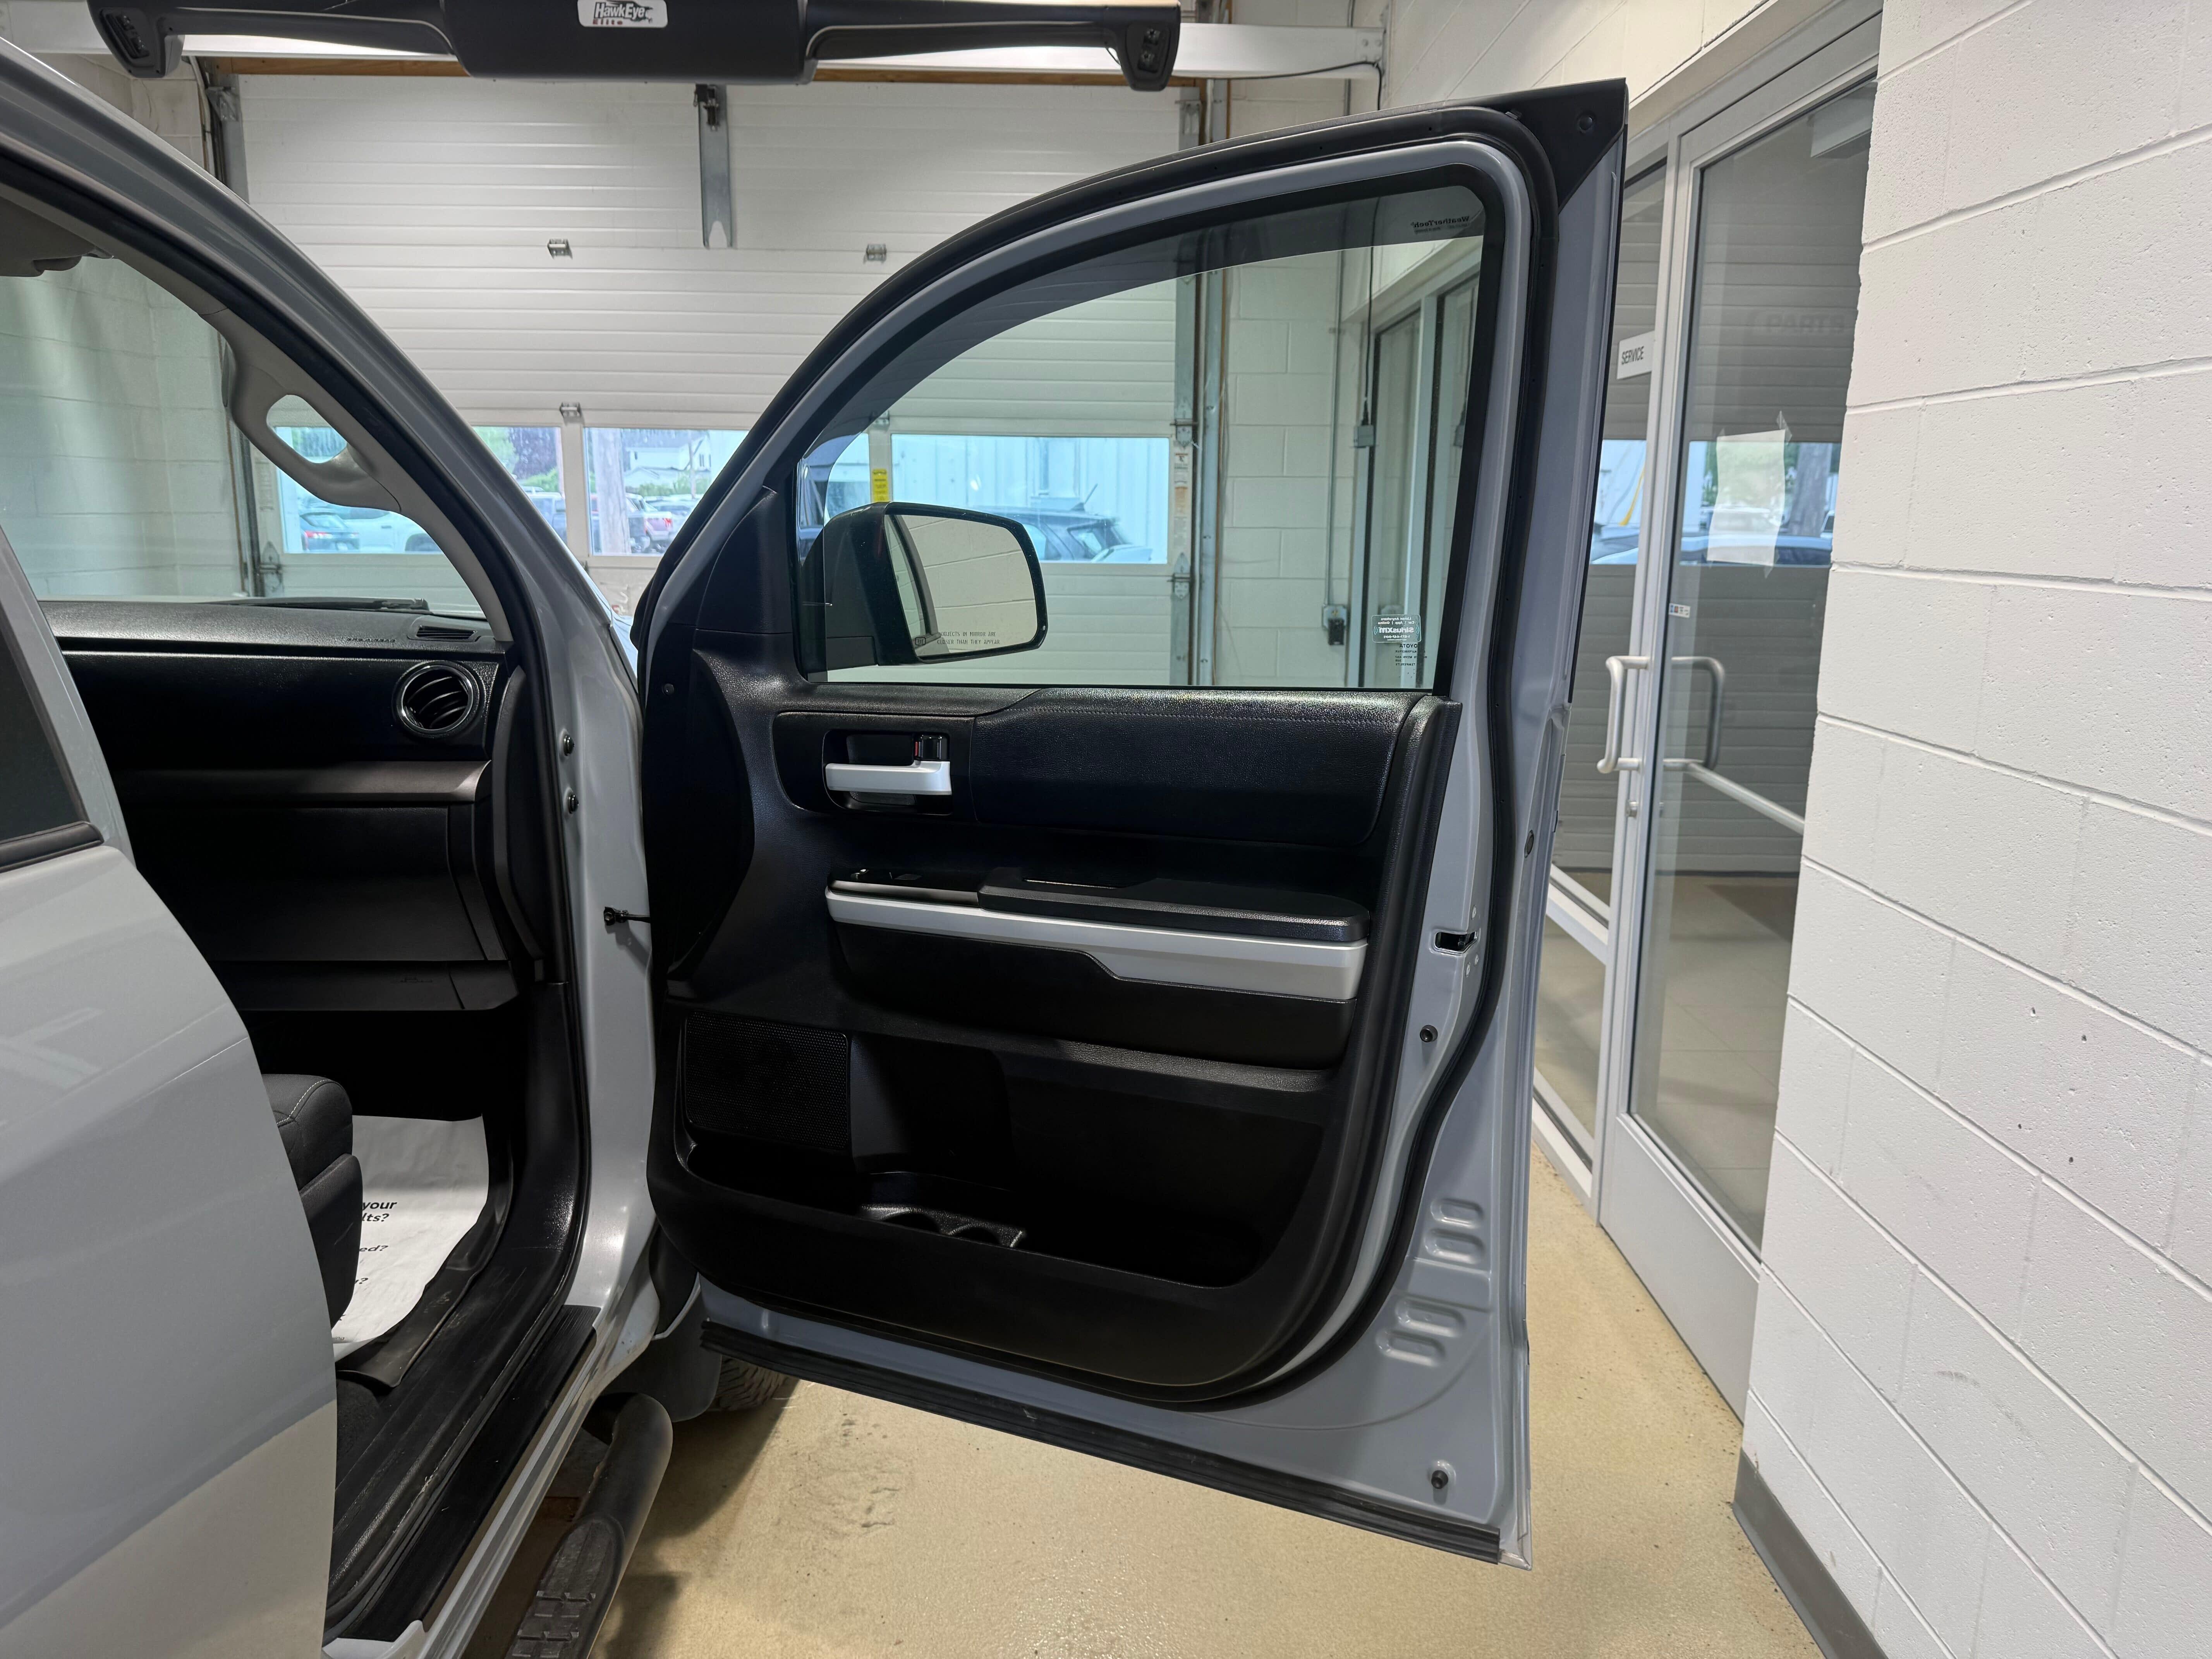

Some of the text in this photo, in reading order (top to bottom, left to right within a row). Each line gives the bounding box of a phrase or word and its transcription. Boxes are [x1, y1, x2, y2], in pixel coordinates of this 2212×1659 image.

[594, 2, 645, 20] HawkEye
[1621, 345, 1644, 365] SERVICE
[362, 1202, 397, 1211] your
